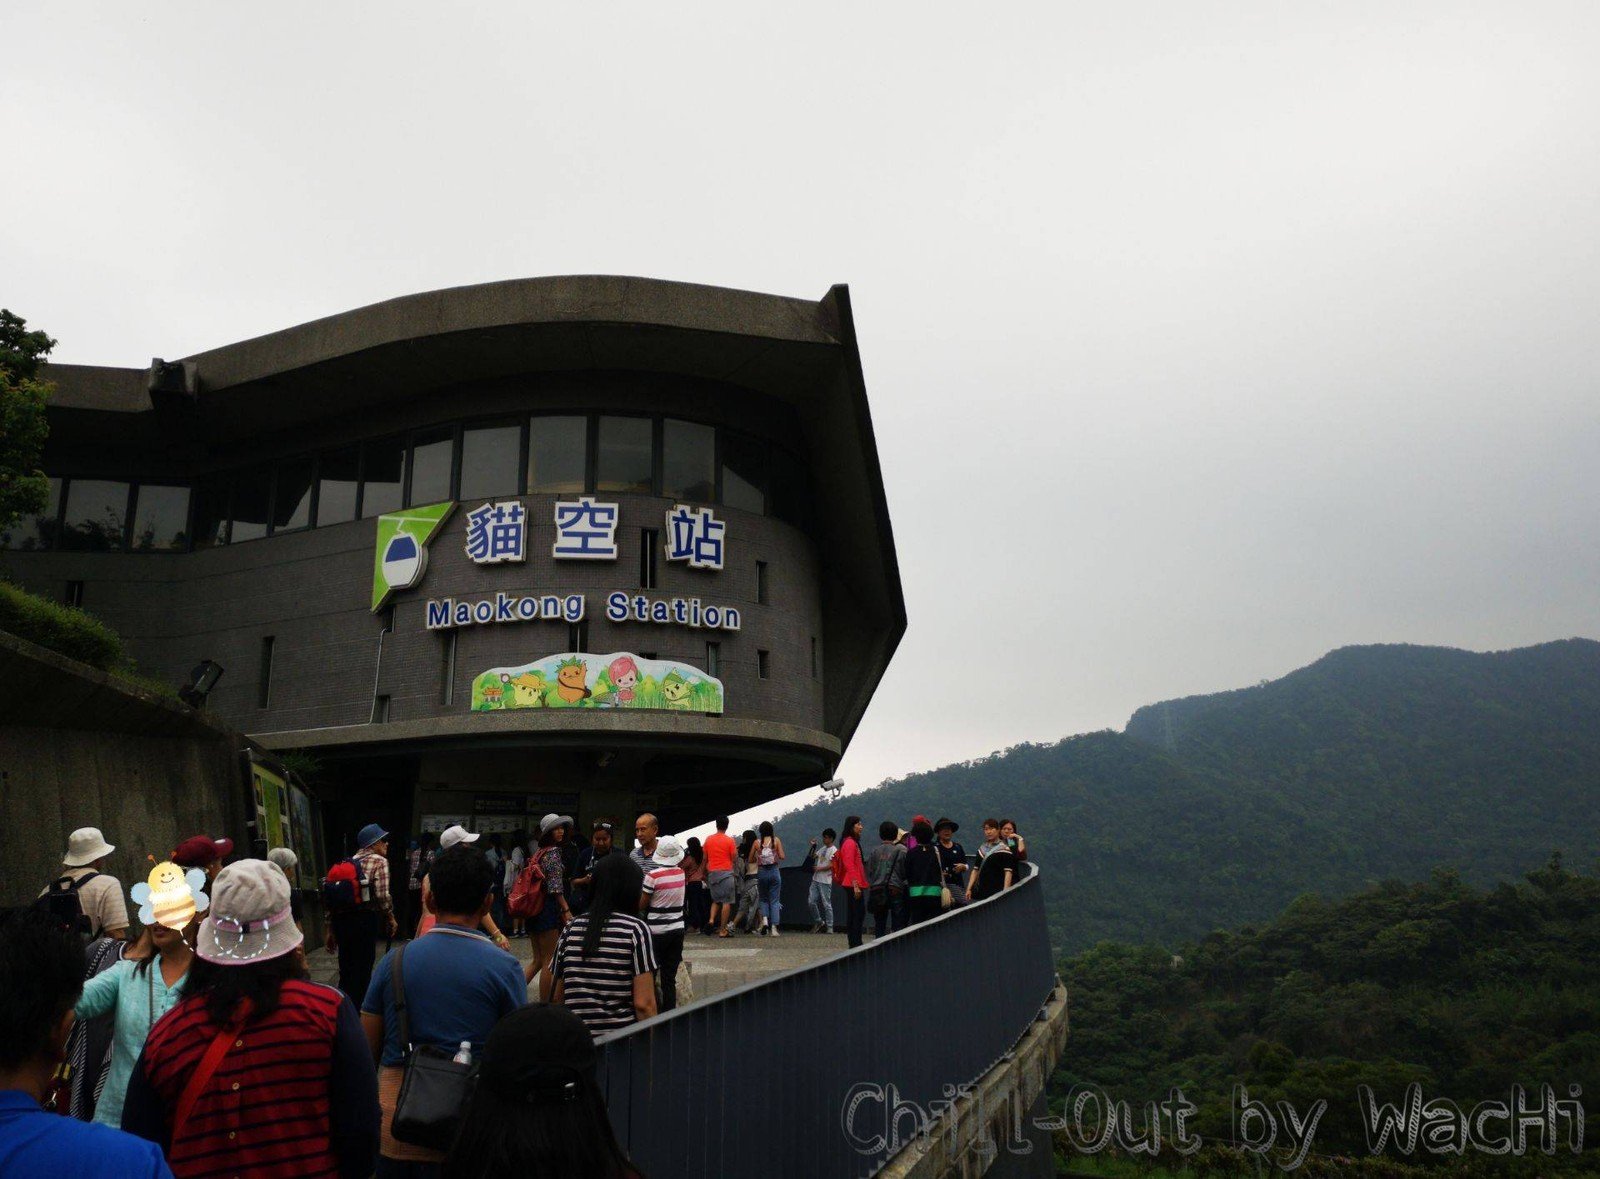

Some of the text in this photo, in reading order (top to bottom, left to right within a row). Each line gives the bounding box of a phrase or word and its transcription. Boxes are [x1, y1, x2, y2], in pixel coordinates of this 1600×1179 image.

[466, 499, 725, 567] 貓空站
[427, 592, 740, 629] Maokong Station
